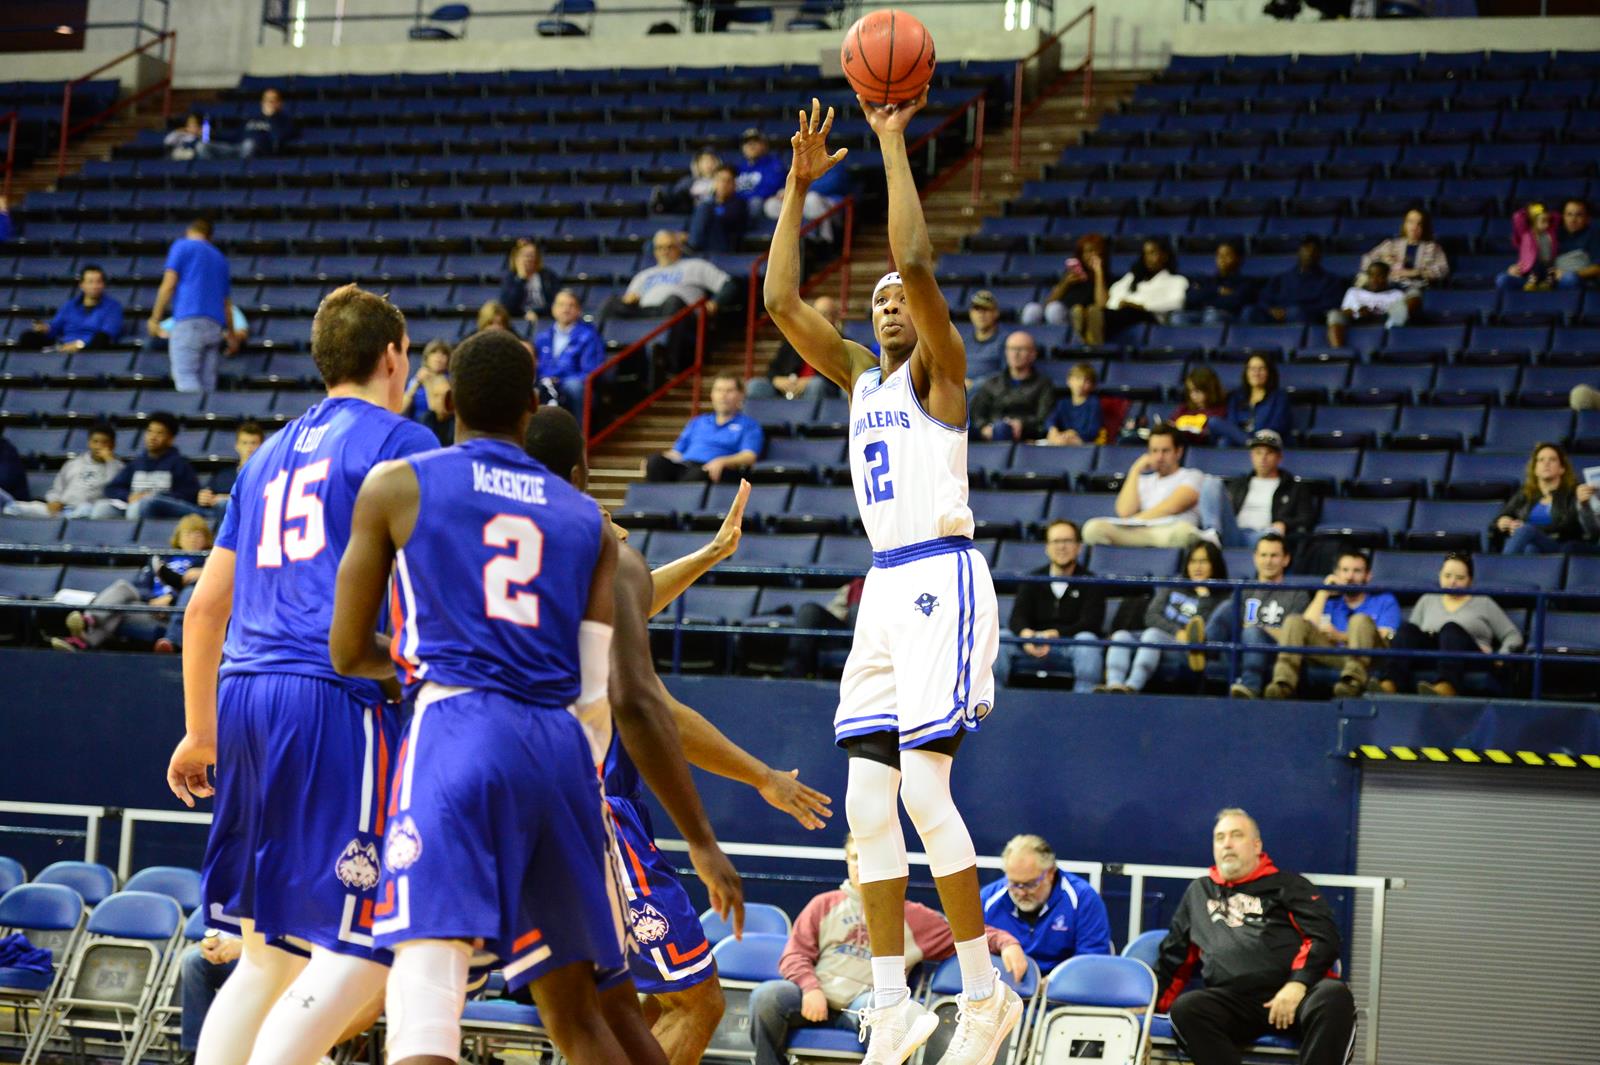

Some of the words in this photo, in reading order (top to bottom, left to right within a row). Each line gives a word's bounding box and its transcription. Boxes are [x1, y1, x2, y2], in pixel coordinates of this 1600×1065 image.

[256, 458, 330, 569] 15
[472, 461, 547, 505] McKENZIE
[863, 440, 895, 506] 12
[482, 513, 544, 628] 2
